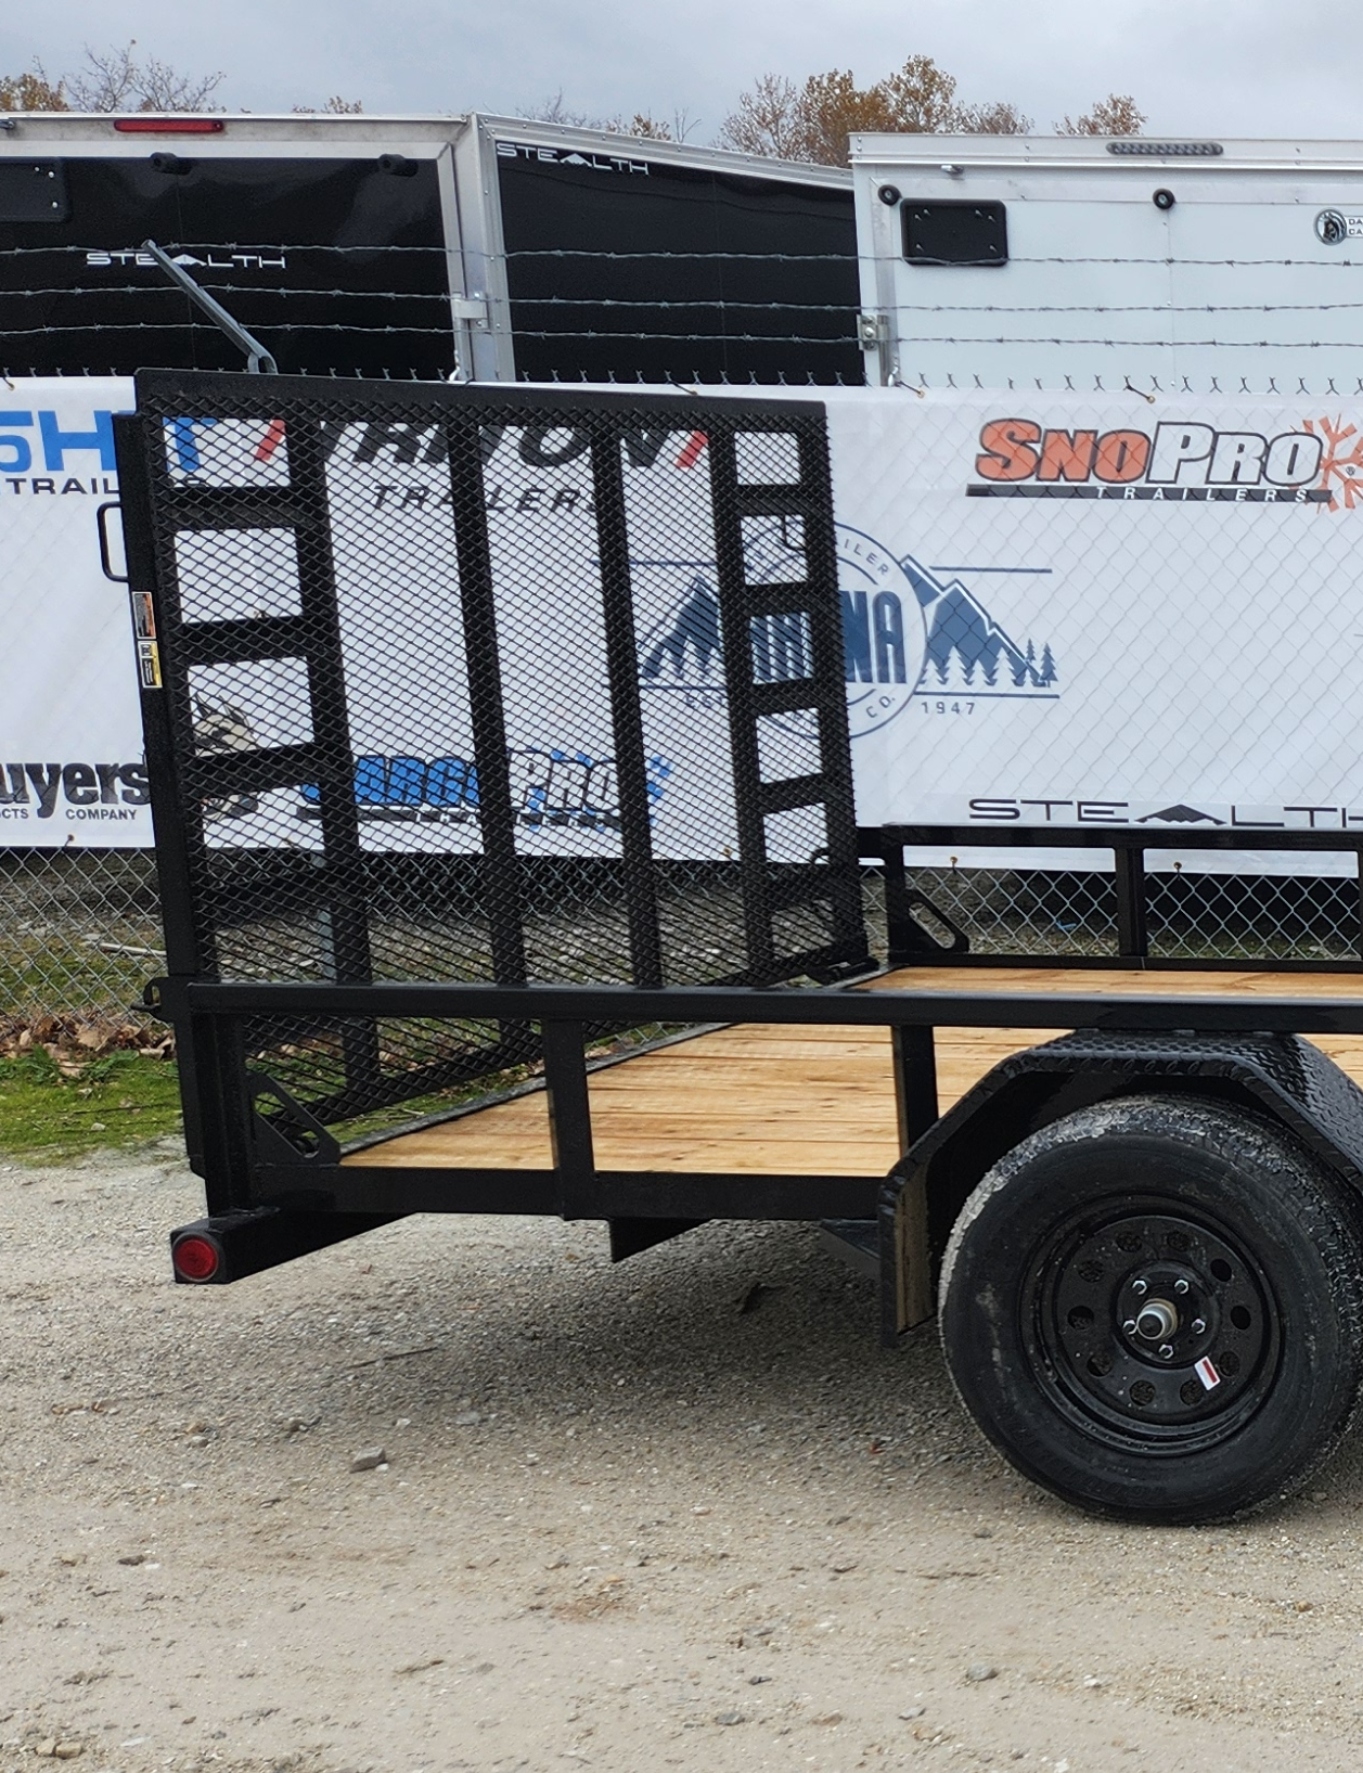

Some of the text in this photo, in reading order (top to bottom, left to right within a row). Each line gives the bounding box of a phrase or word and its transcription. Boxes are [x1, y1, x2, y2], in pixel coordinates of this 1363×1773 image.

[496, 142, 649, 176] STEALTH
[86, 251, 287, 269] STEALTH
[1096, 486, 1310, 502] TRAILERS
[920, 701, 977, 716] 1947
[66, 808, 138, 820] COMPANY
